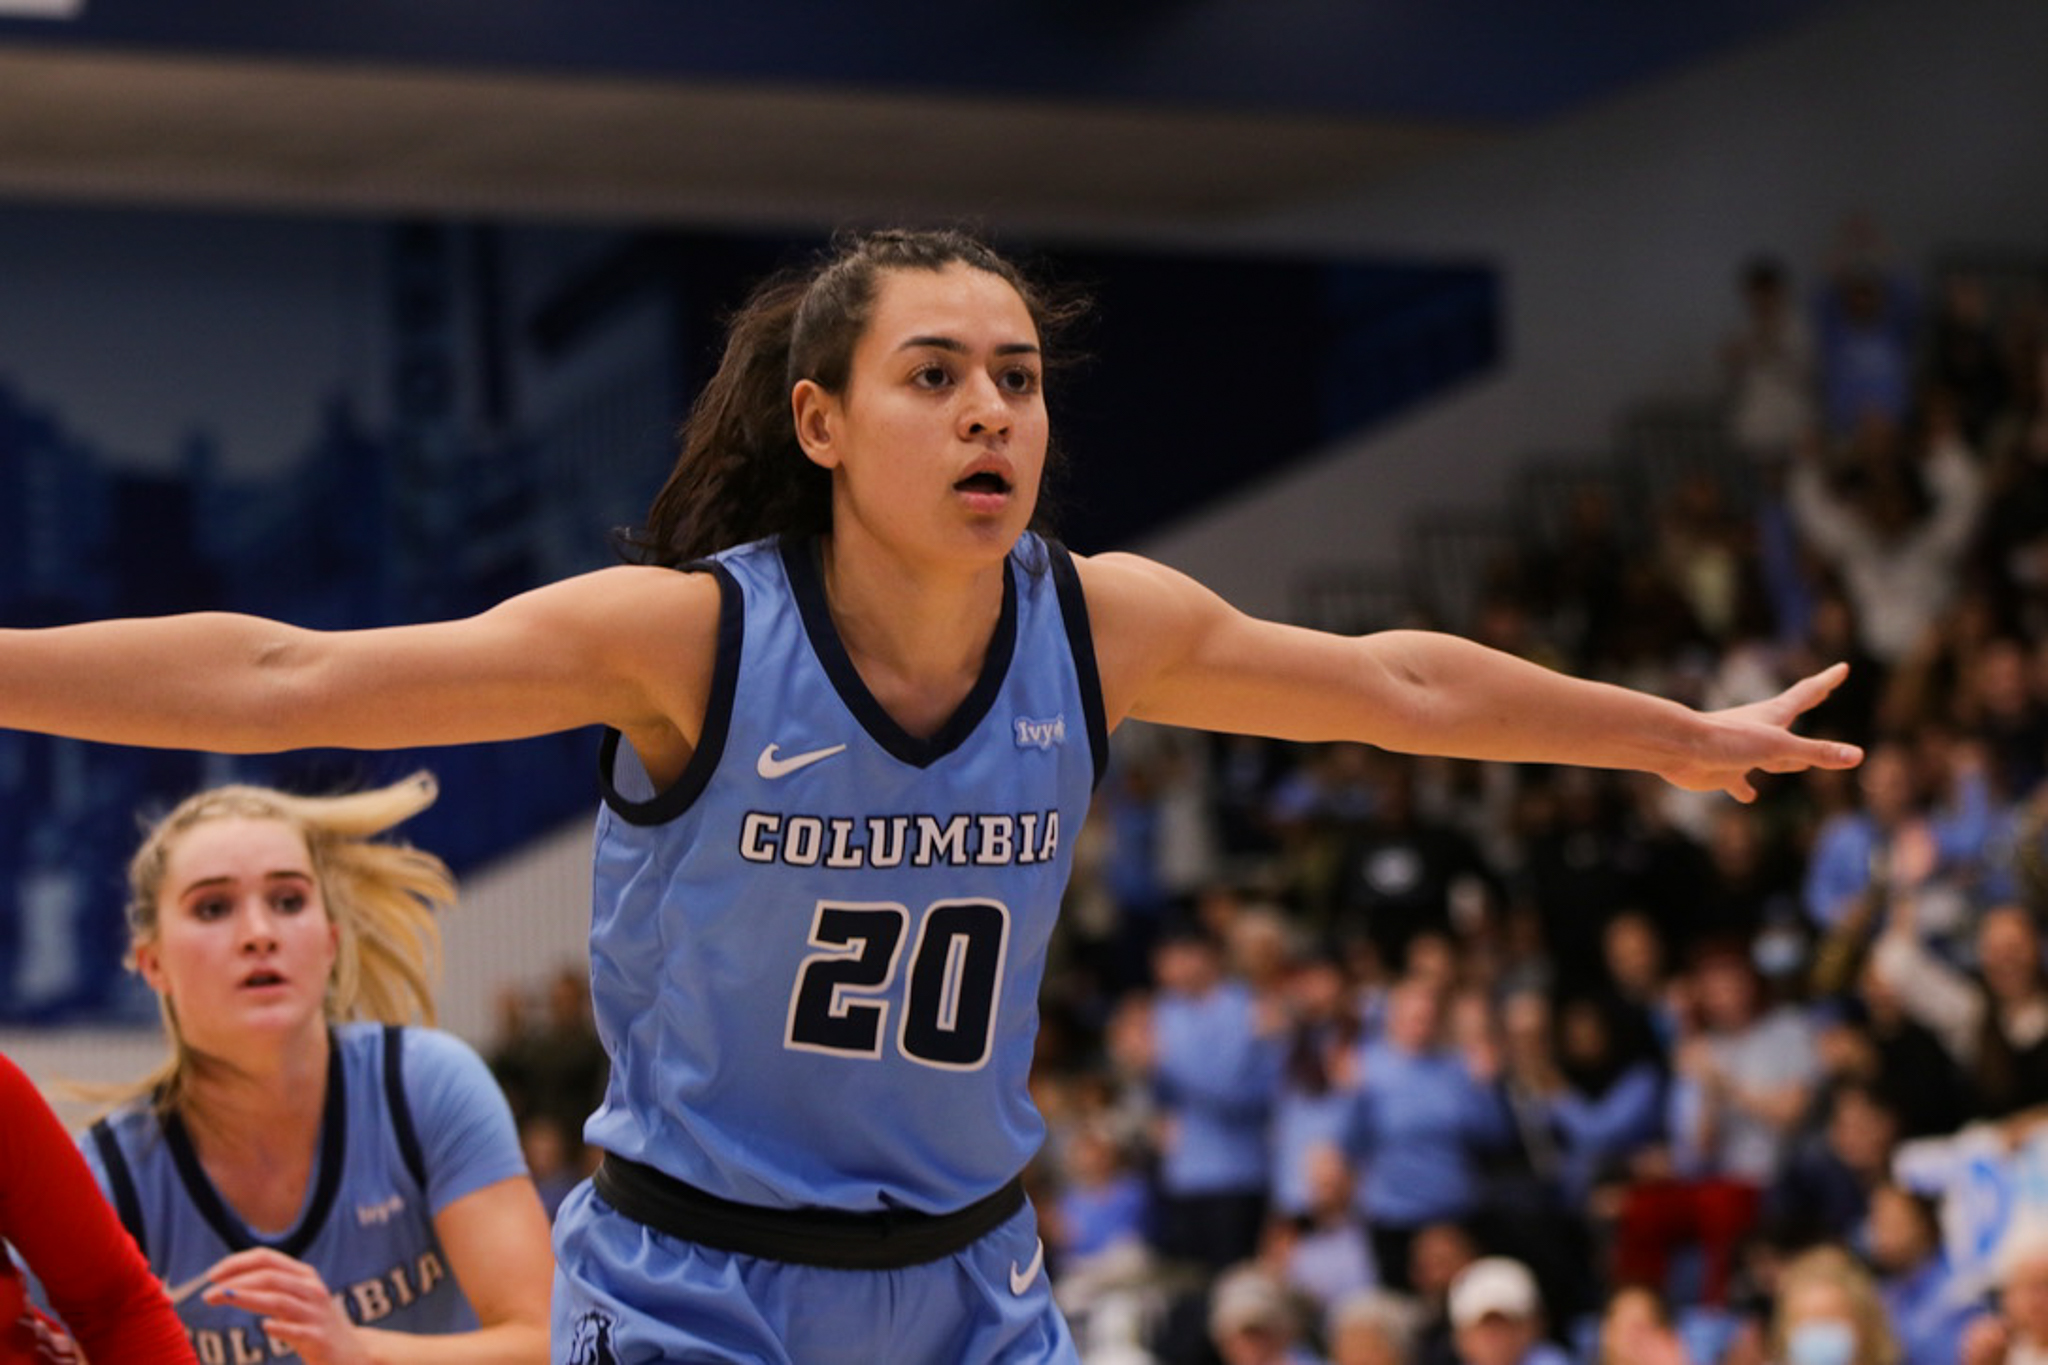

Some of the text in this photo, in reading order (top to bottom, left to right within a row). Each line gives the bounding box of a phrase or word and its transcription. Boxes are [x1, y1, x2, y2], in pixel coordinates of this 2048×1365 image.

[1017, 719, 1054, 749] Ivy
[739, 809, 1059, 869] COLUMBIA
[784, 897, 1011, 1072] 20
